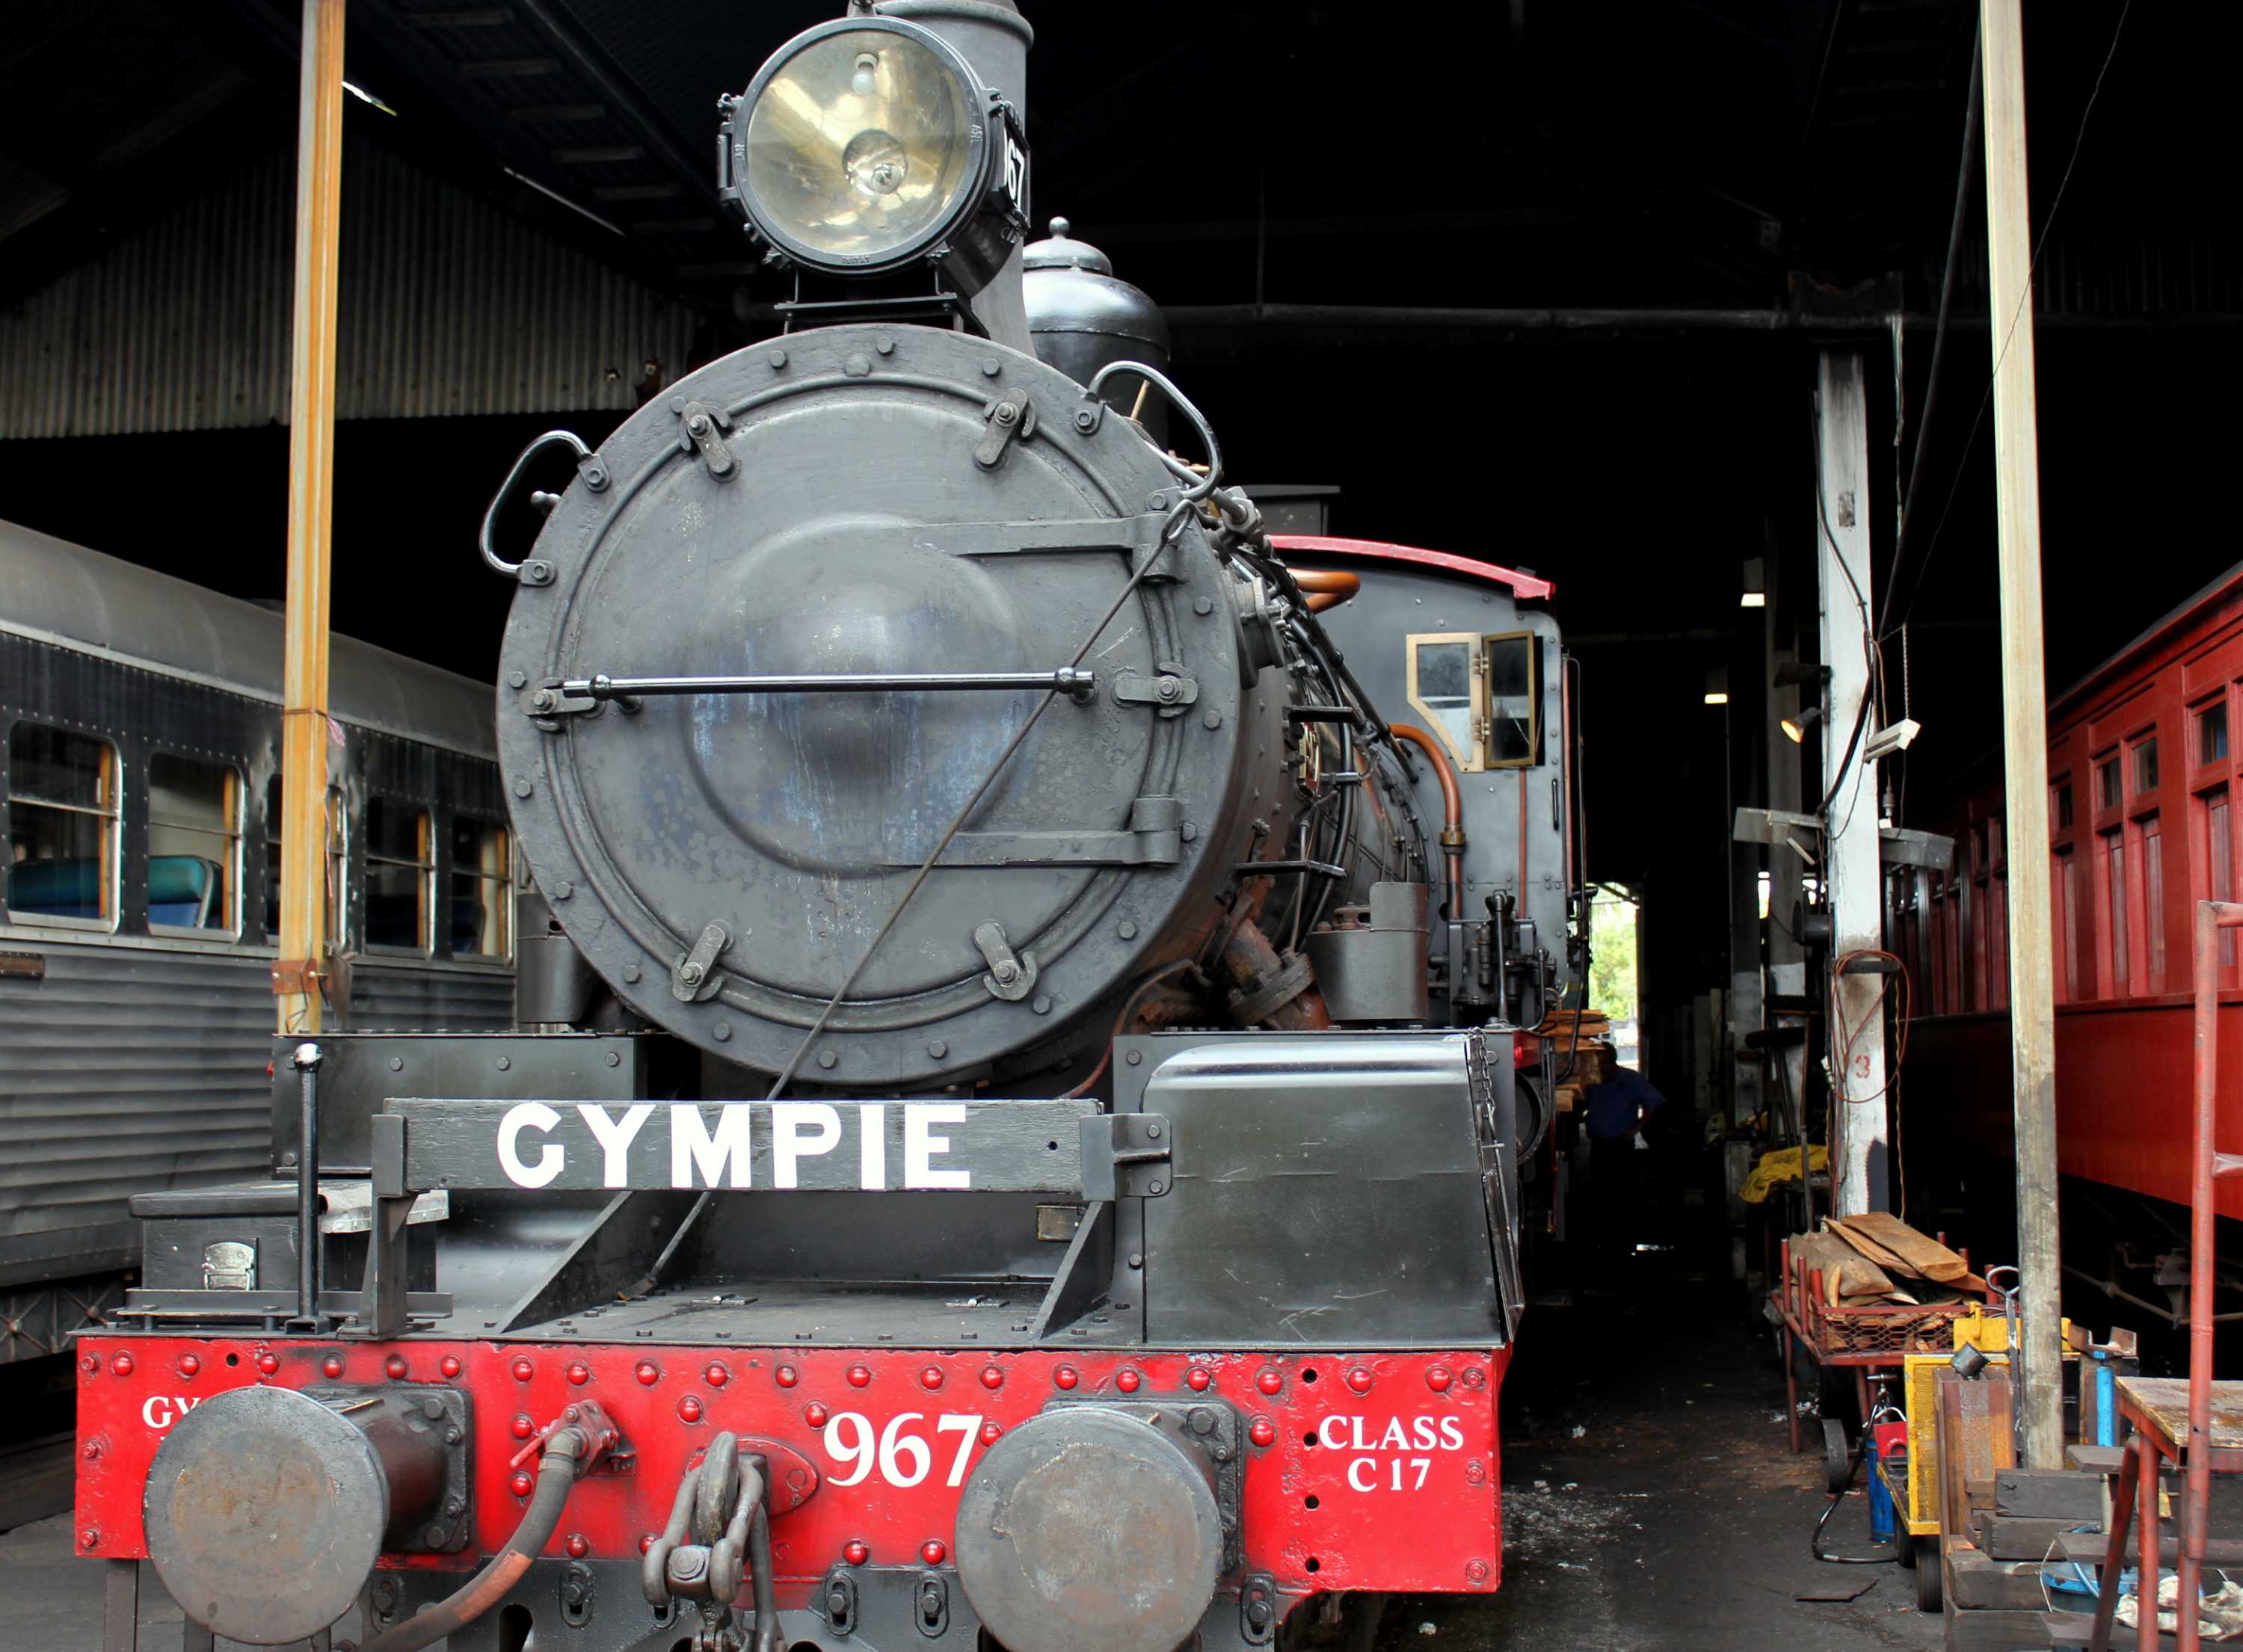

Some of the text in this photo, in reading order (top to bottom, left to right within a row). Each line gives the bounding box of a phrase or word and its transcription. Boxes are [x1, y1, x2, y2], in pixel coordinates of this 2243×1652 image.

[1855, 1055, 1870, 1078] 3
[497, 1102, 970, 1190] GYMPIE
[823, 1411, 983, 1488] 967
[1319, 1415, 1463, 1450] CLASS
